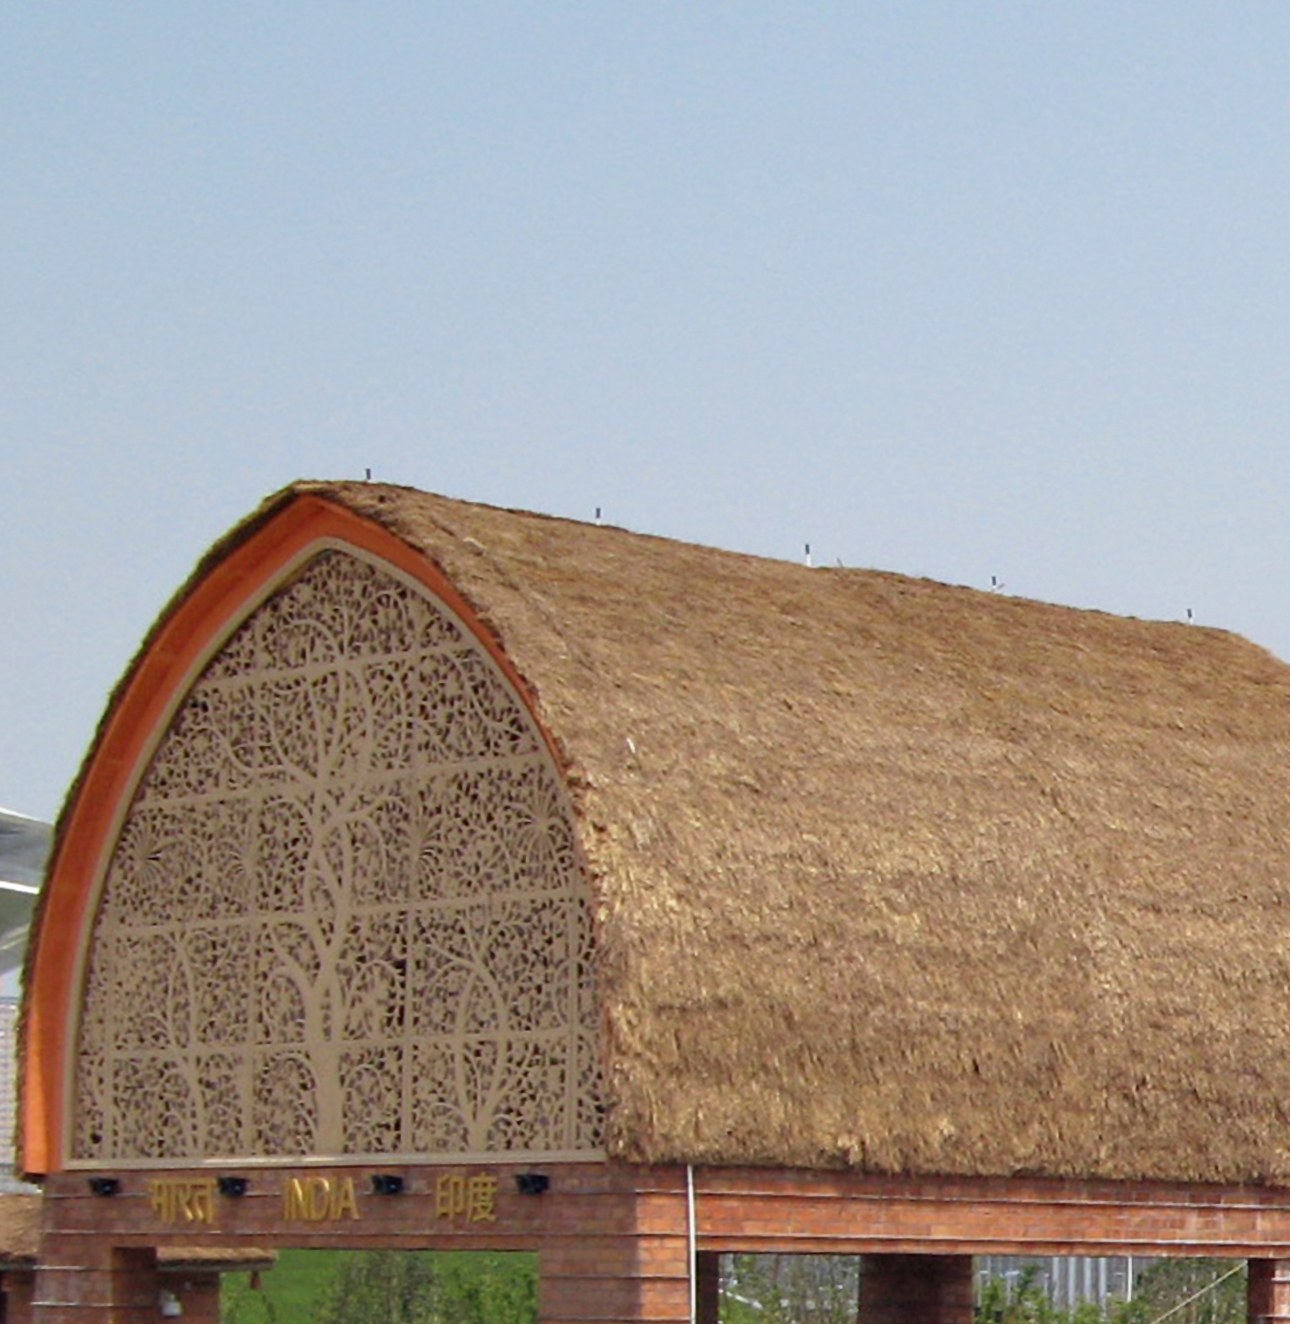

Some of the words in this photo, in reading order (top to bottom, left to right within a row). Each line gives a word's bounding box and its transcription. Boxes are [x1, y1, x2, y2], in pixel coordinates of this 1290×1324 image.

[149, 1177, 219, 1224] भारत
[284, 1177, 360, 1221] INDIA
[435, 1172, 498, 1223] 印度
